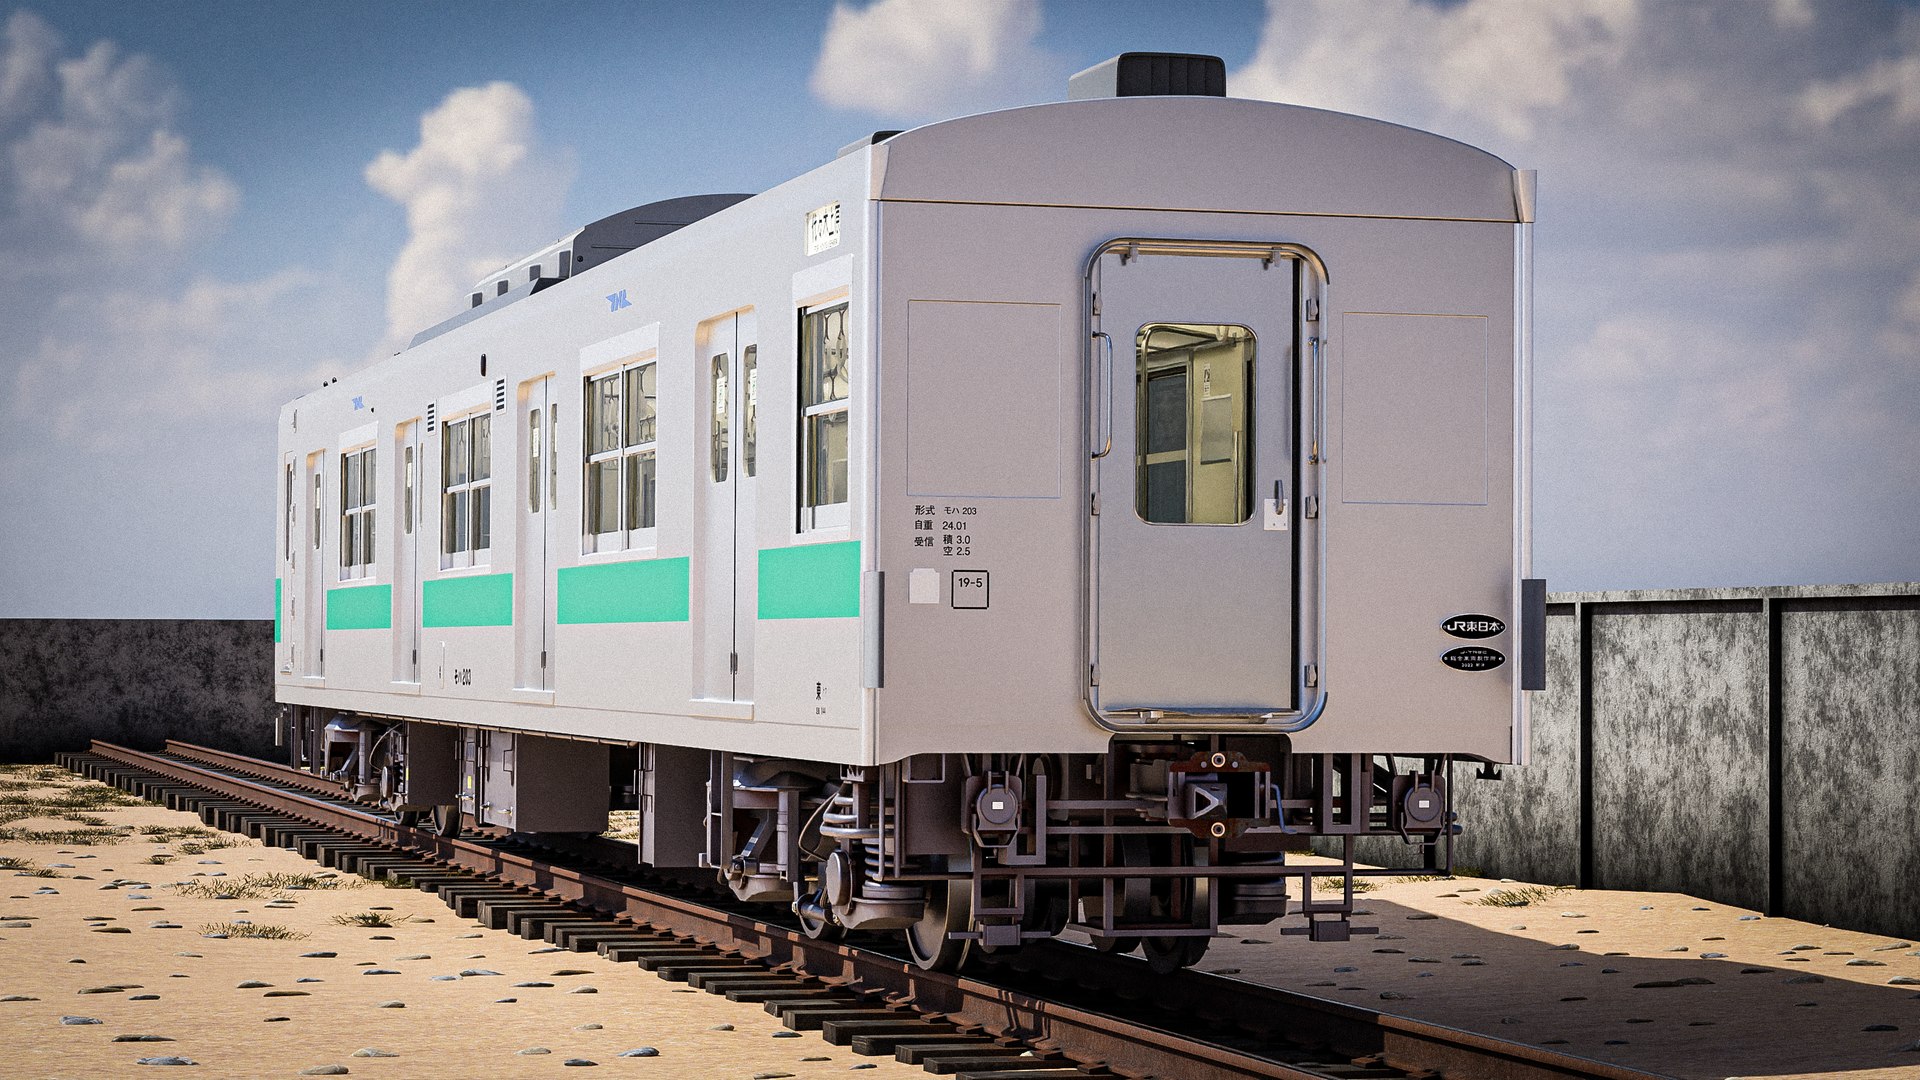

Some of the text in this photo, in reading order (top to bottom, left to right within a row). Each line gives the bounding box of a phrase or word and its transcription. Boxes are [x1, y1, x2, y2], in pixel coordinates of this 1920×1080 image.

[914, 505, 977, 515] 形式 モハ 203
[914, 520, 967, 530] 自重 24.01
[956, 535, 971, 545] 3.0
[943, 546, 971, 556] 空 2.5
[958, 577, 983, 588] 19-5
[1447, 621, 1501, 632] JR東日本
